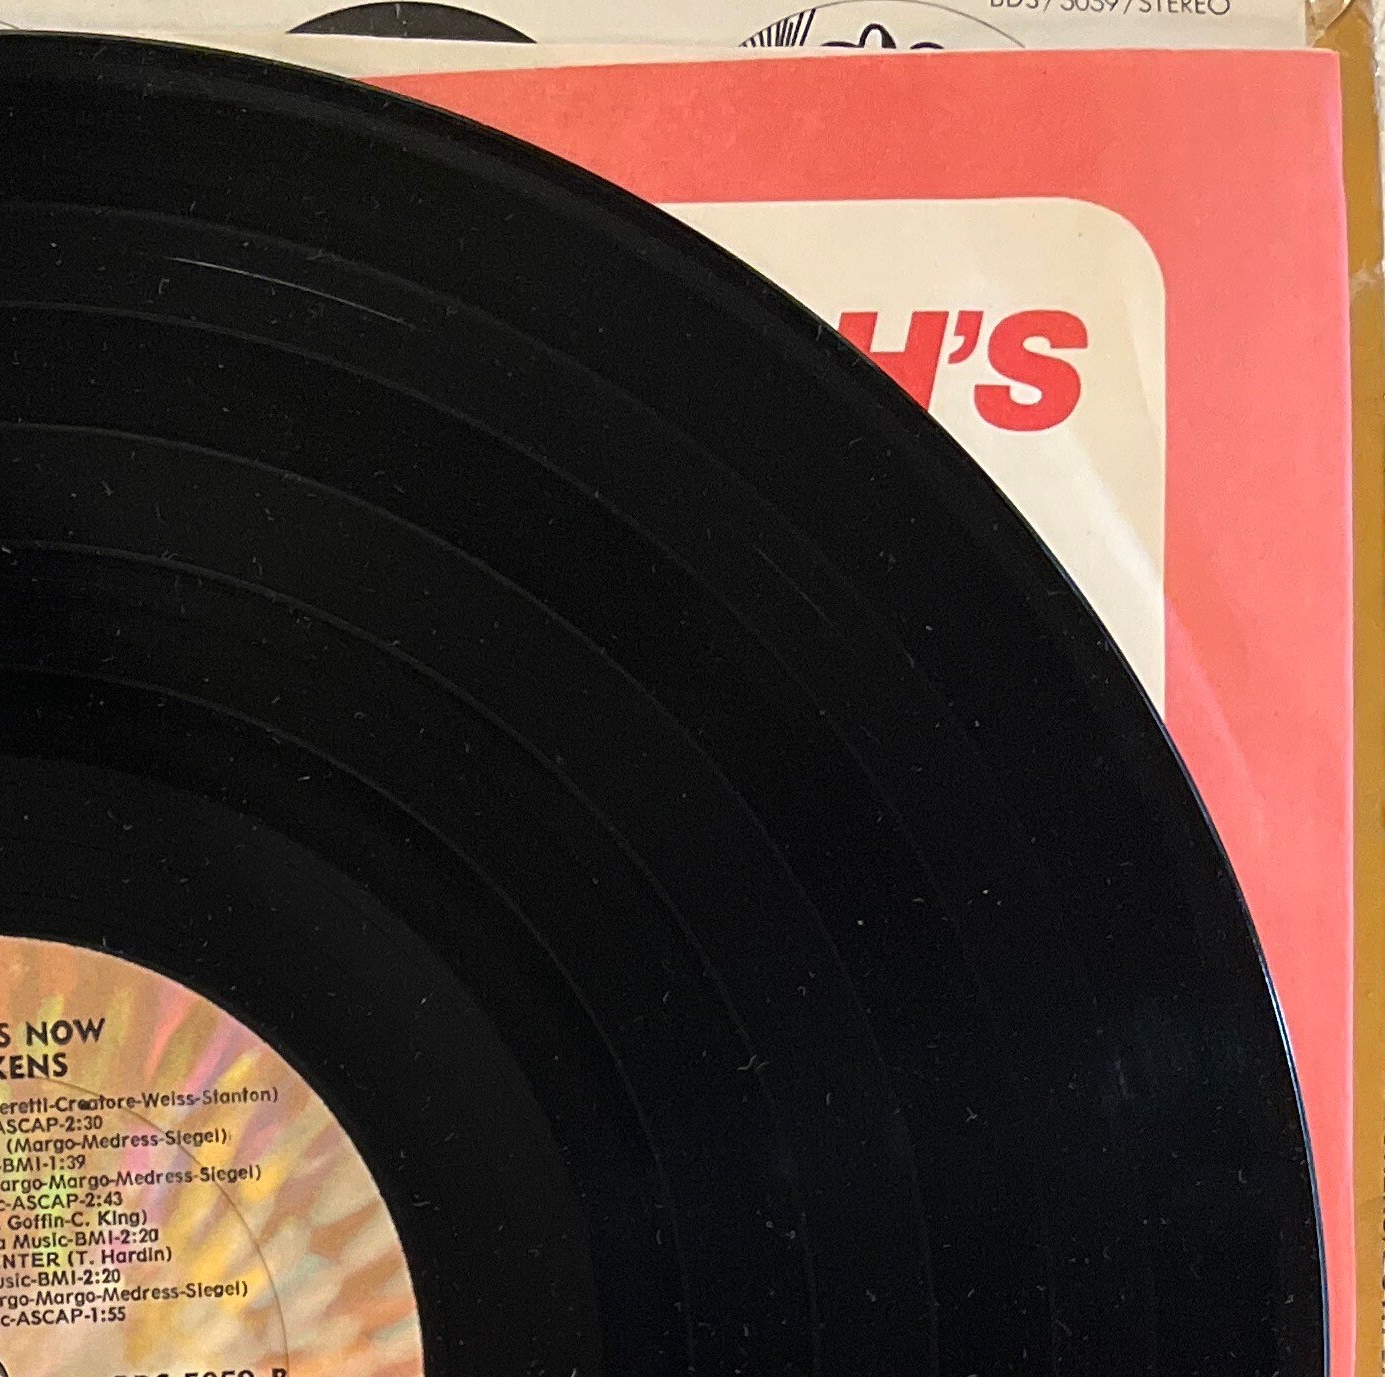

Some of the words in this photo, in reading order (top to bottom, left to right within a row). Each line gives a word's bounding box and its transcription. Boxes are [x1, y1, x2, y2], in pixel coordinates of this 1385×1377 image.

[26, 1017, 105, 1046] NOW
[7, 1128, 228, 1154] (Margo-Medress-Siegel)
[7, 1211, 90, 1232] Goffin-C.
[98, 1209, 147, 1228] King)
[13, 1228, 159, 1249] Music-BMI-2:20
[67, 1249, 94, 1267] (T.
[101, 1246, 172, 1265] Hardin)
